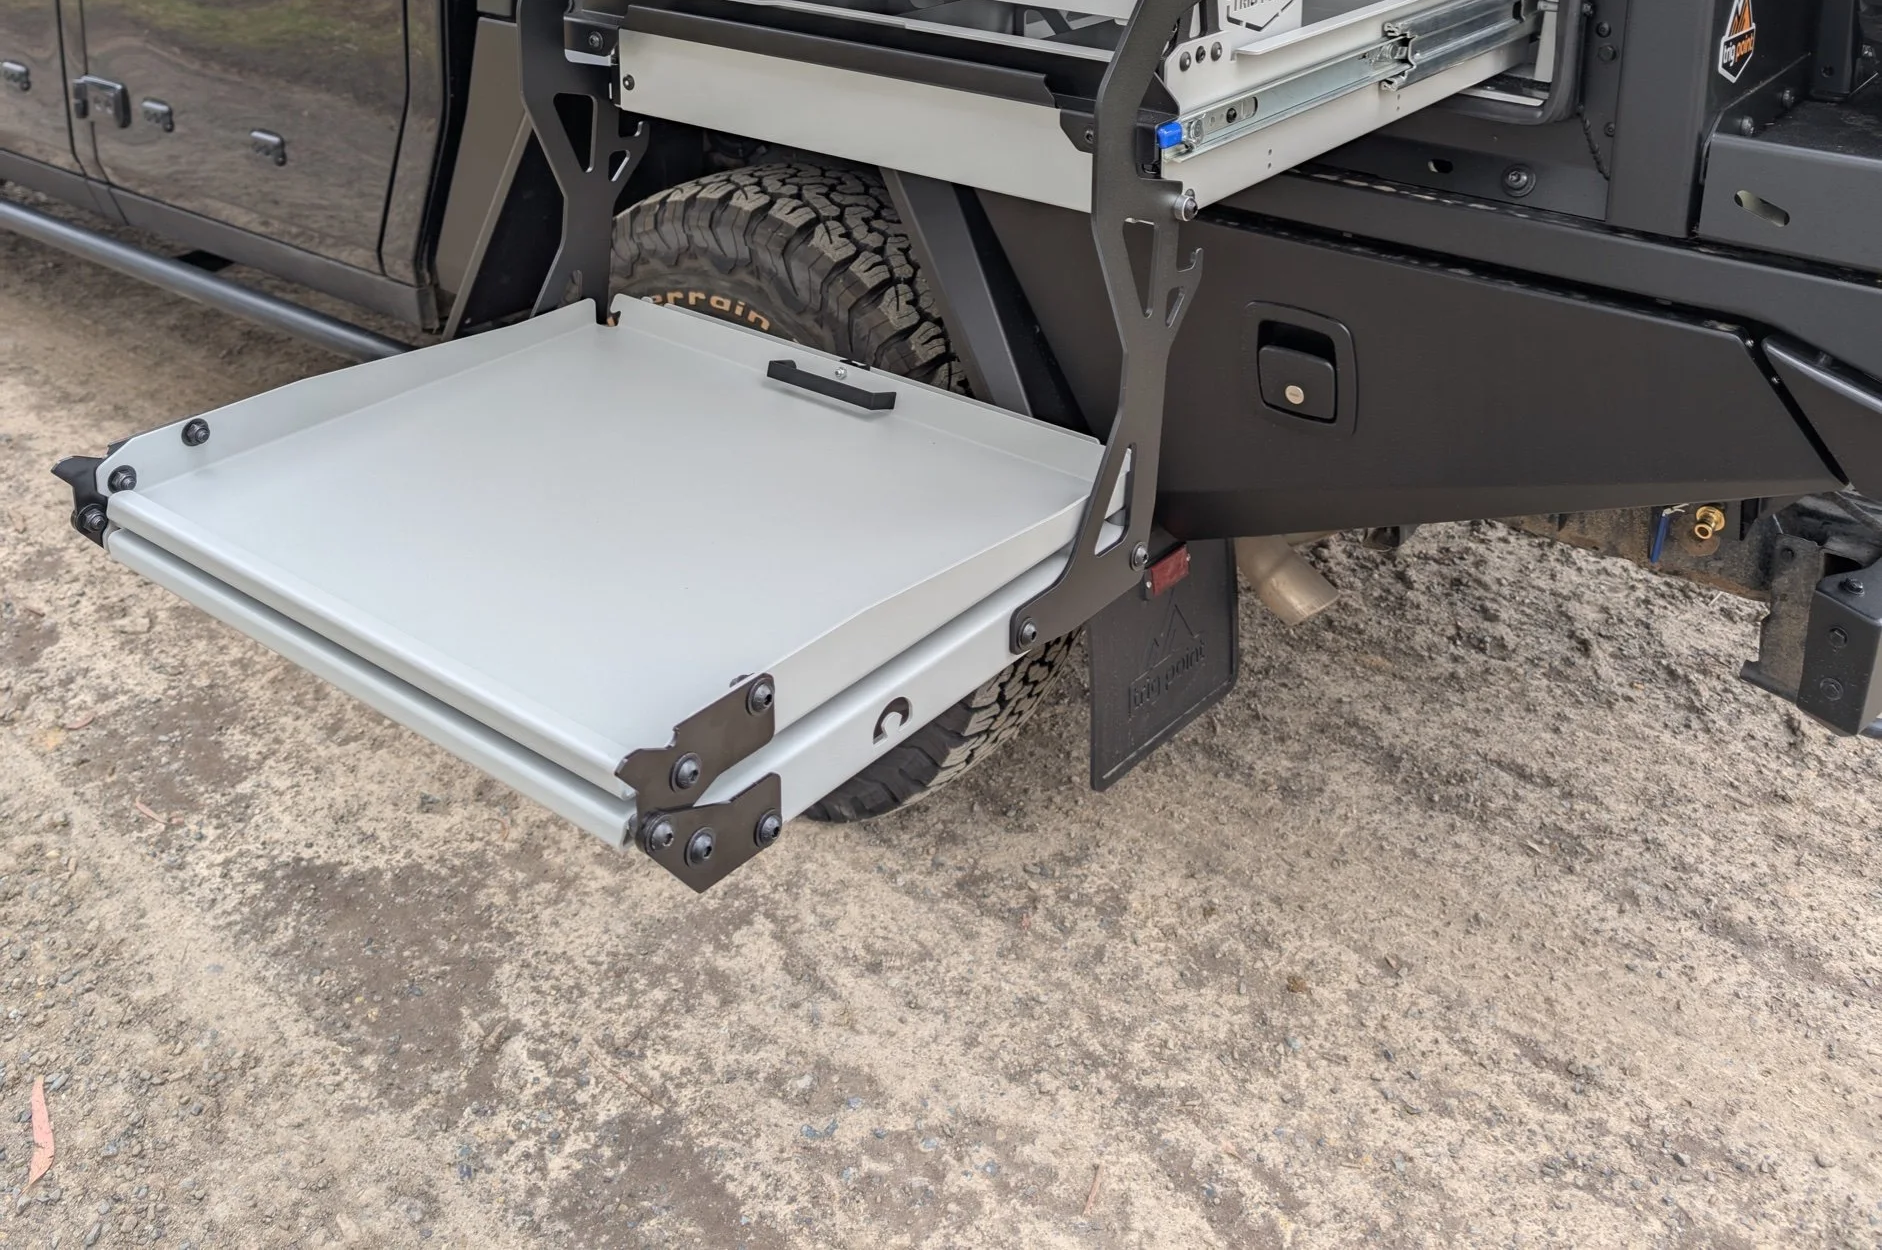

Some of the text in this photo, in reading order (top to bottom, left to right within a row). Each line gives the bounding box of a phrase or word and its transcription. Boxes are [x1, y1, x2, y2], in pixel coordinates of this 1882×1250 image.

[1722, 32, 1754, 67] trig point
[1133, 639, 1206, 707] trig point
